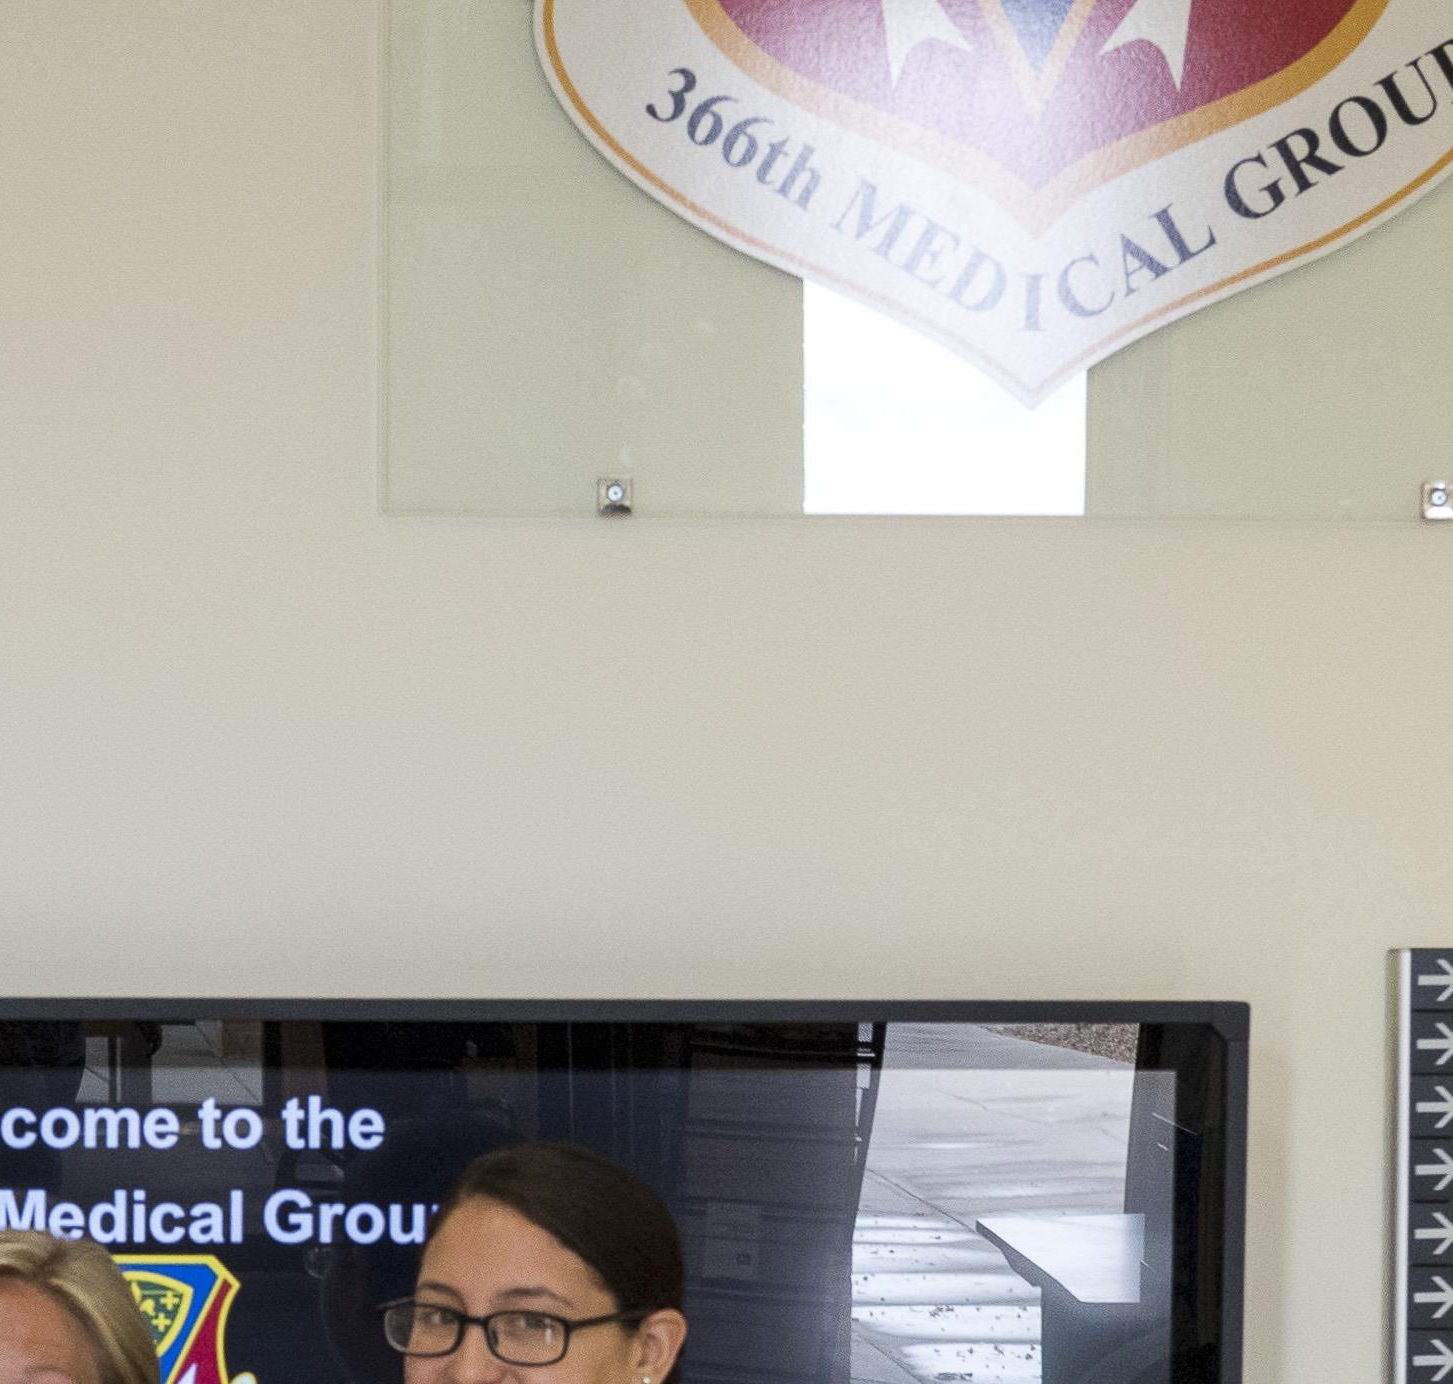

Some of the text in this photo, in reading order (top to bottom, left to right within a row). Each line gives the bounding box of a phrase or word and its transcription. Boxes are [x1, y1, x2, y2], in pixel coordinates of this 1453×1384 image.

[644, 67, 825, 213] 366th
[832, 177, 1220, 335] MEDICAL
[198, 1096, 263, 1149] to
[281, 1095, 385, 1150] the
[263, 1189, 439, 1246] Grou
